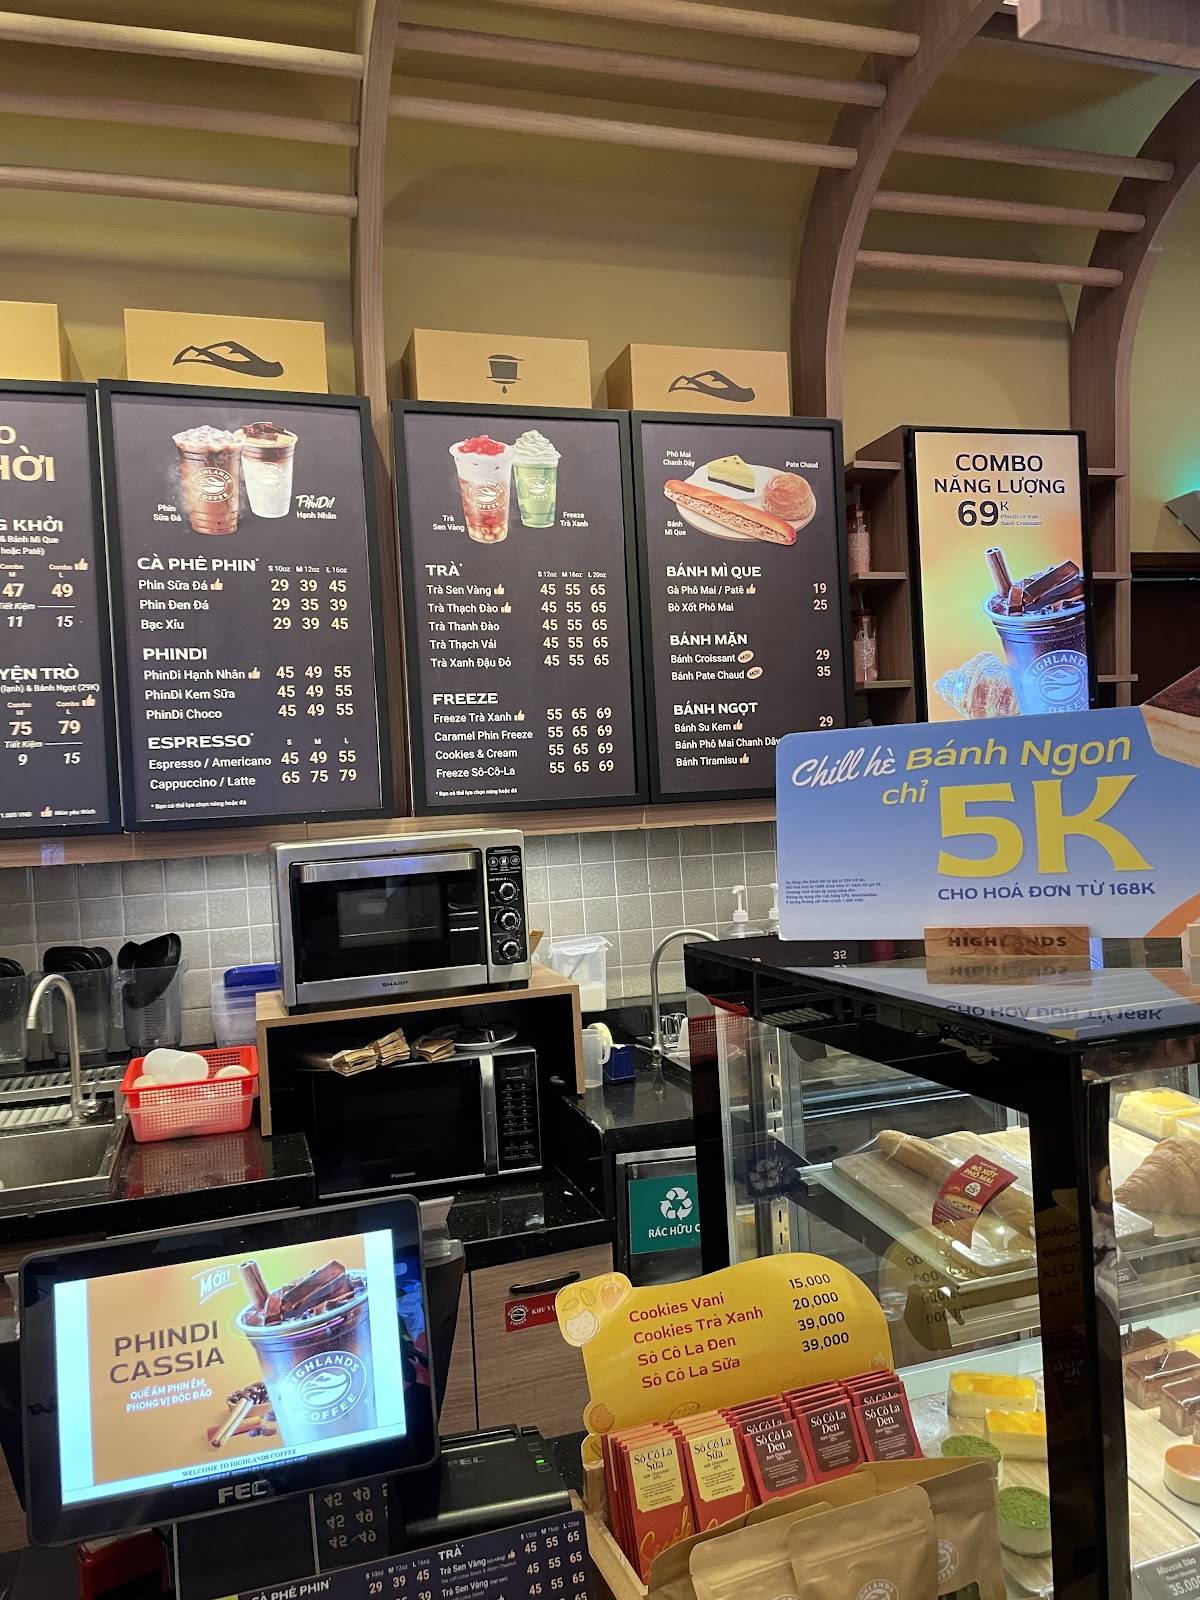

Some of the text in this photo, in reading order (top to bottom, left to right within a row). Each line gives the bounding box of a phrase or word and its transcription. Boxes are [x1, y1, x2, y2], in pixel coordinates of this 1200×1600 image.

[956, 454, 1042, 472] COMBO
[934, 474, 1065, 497] NĂNG LƯỢNG
[13, 516, 64, 532] KHỞI
[137, 553, 164, 571] CÀ
[169, 555, 208, 571] PHÊ
[666, 562, 761, 579] BÁNH MÌ QUE
[2, 583, 73, 598] 47 49
[138, 579, 346, 592] Phin Sữa Đá 29 39 45
[426, 584, 606, 597] Trà Sen Vàng 45 55 65
[667, 585, 680, 595] Gà
[682, 585, 698, 594] Phô
[701, 585, 716, 594] Mai
[724, 585, 744, 594] Patê
[813, 583, 827, 594] 19
[140, 598, 348, 611] Phin Đen Đá 29 35 39
[7, 616, 73, 628] 11 15
[428, 619, 607, 631] Trà Thanh Đào 45 55 65
[670, 631, 748, 646] BÁNH MẶN
[143, 647, 208, 660] PHINDI
[40, 663, 79, 680] TRÒ
[671, 671, 693, 680] Bánh
[696, 671, 715, 680] Pate
[717, 670, 744, 679] Chaud
[817, 666, 831, 677] 35
[432, 692, 499, 705] FREEZE
[146, 703, 353, 719] PhinDi Choco 45 49 55
[434, 707, 611, 723] Freeze Trà Xanh 55 65 69
[674, 701, 758, 716] BÁNH NGỌT
[9, 721, 81, 736] 75 79
[18, 752, 81, 765] 9 15
[435, 743, 613, 759] Cookies & Cream 55 65 69
[149, 759, 201, 771] Espresso
[212, 757, 271, 768] Americano
[281, 752, 299, 765] 45
[309, 751, 327, 764] 49
[338, 750, 356, 762] 55
[676, 756, 737, 766] Bánh Tiramisu
[792, 736, 1132, 788] Chill hè Bánh Ngon
[882, 774, 1154, 877] chỉ 5K
[938, 880, 1156, 901] CHO HOÁ ĐƠN TỪ 168K
[649, 1224, 692, 1237] RÁC HỮU
[629, 1301, 688, 1323] Cookies
[692, 1292, 725, 1309] Vani
[633, 1292, 839, 1344] Cookies Trà Xanh 20,000
[115, 1320, 218, 1356] PHINDI
[638, 1311, 845, 1366] Sô Cô La Đen 39,000
[110, 1346, 225, 1384] CASSIA
[642, 1332, 849, 1389] Sô Cô La Sữa 39,000
[168, 1382, 189, 1392] PHIN
[127, 1399, 158, 1413] PHONG
[694, 1437, 732, 1455] Sô Cô La
[755, 1429, 792, 1447] Sô Cô La
[182, 1464, 218, 1477] WELCOME
[230, 1455, 269, 1468] HIGHLANDS
[271, 1449, 296, 1459] COFFEE
[707, 1449, 723, 1461] Sữa
[440, 1567, 451, 1576] Trà
[453, 1564, 466, 1573] Sen
[467, 1558, 486, 1569] Vàng
[524, 1542, 537, 1553] 45
[546, 1536, 558, 1548] 55
[567, 1531, 580, 1542] 65
